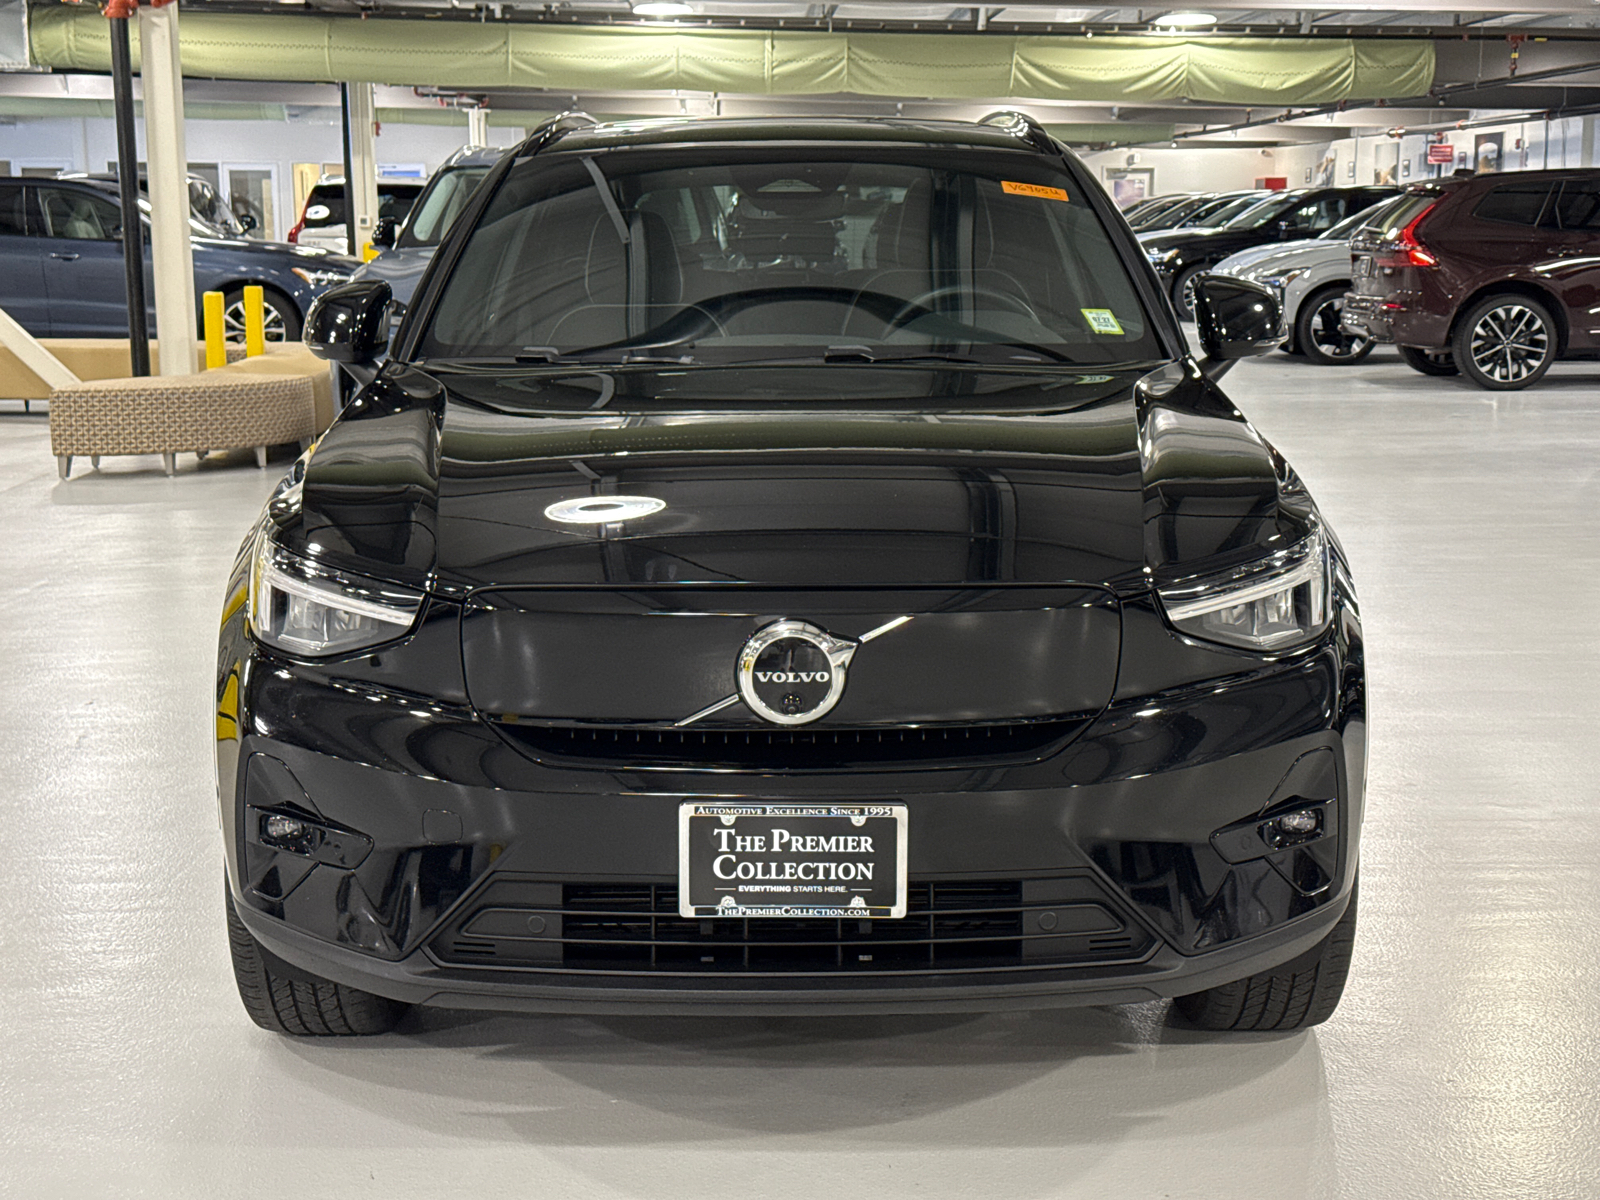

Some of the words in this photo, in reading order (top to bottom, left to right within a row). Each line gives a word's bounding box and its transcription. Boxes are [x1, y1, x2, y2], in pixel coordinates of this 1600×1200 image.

[755, 671, 830, 683] VOLVO
[696, 806, 763, 815] AUTOMOTIVE
[765, 806, 828, 815] EXCELLENCE
[830, 807, 861, 816] SINCE
[864, 807, 891, 816] 1995
[713, 828, 766, 852] THE
[770, 828, 875, 853] PREMIER
[712, 854, 875, 881] COLLECTION
[792, 885, 823, 893] STARTS
[824, 885, 848, 893] HERE.
